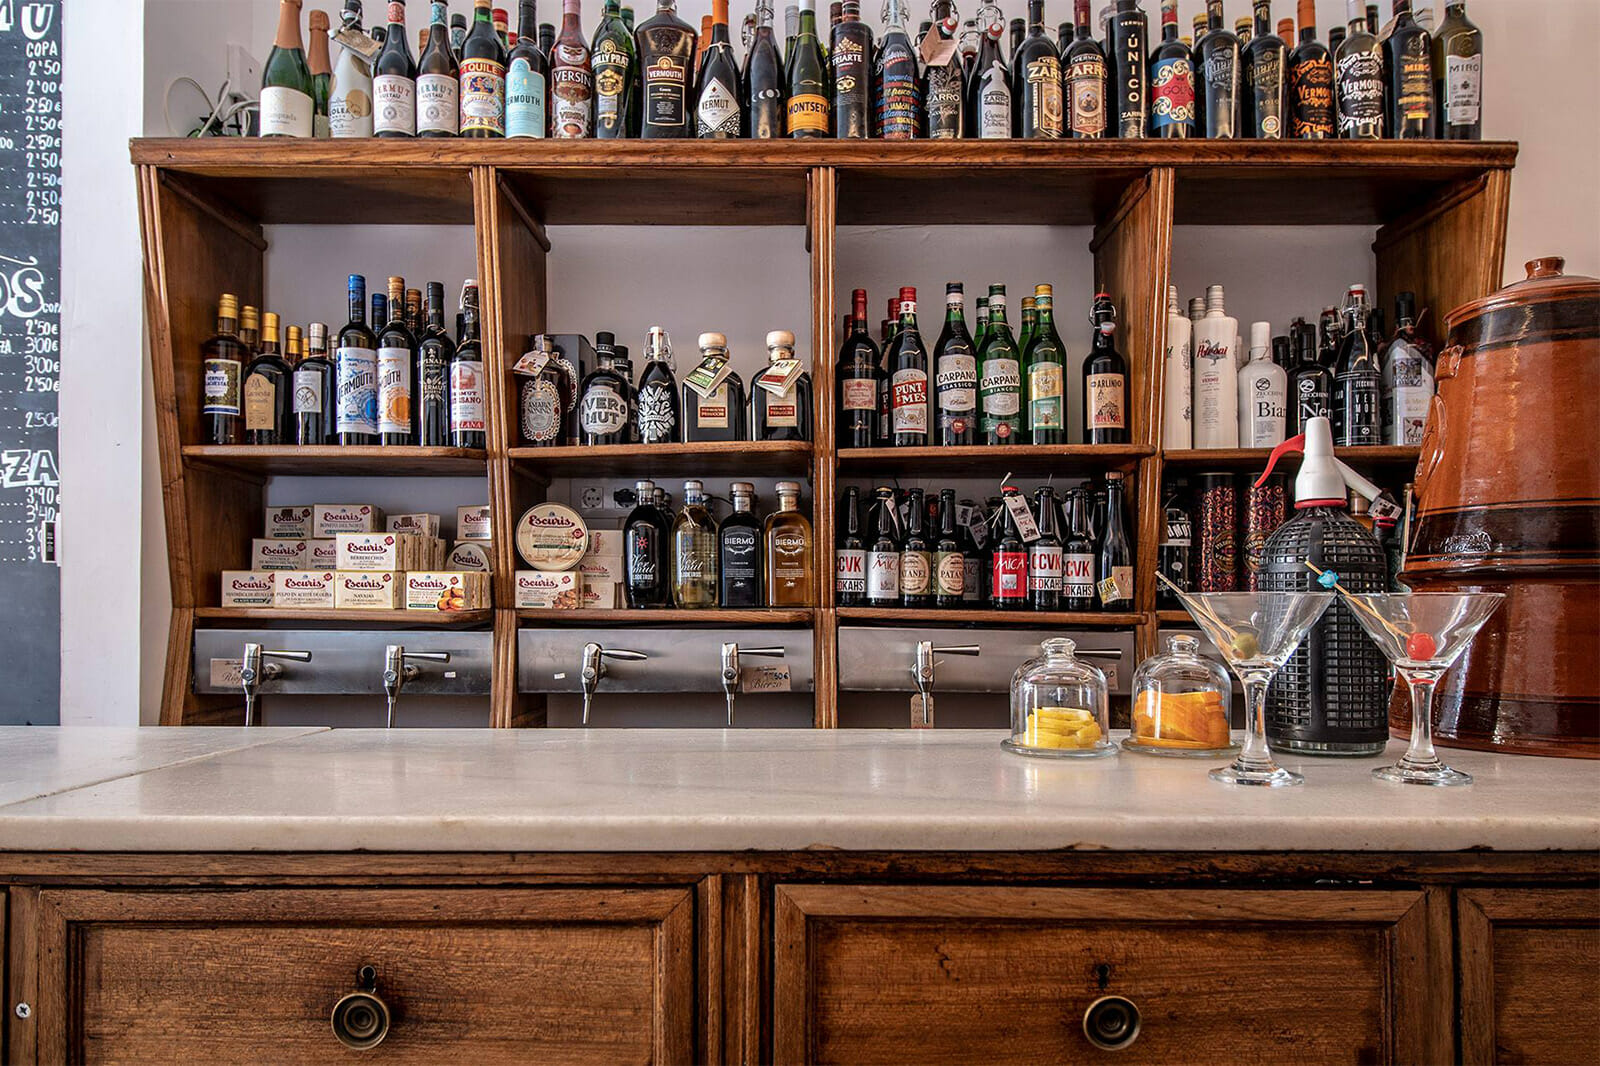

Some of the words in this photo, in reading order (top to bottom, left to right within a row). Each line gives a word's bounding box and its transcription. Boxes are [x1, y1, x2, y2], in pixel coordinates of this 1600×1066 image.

[26, 41, 58, 58] COPA
[1064, 63, 1108, 81] ZARRO
[1127, 33, 1139, 102] ÚNICO
[649, 69, 682, 79] VERMOUTH
[506, 94, 541, 107] ERMOUTH
[702, 99, 729, 111] VERMUT
[25, 319, 59, 335] 2'50€
[938, 370, 976, 383] CARPANO
[982, 375, 1019, 388] CARPANO
[895, 382, 923, 396] PUNT
[989, 386, 1014, 394] BIANCO
[902, 393, 927, 404] MES
[0, 449, 60, 488] ZA
[323, 511, 363, 523] Escuris
[529, 515, 575, 528] Escuris
[261, 546, 299, 557] Escuris
[314, 547, 336, 557] Escur
[347, 542, 388, 554] Escuris
[453, 552, 483, 567] Escuris
[837, 556, 862, 573] CVK
[994, 557, 1025, 571] MICA
[232, 580, 271, 591] Escuris
[285, 578, 326, 589] Escuris
[345, 579, 385, 590] Escuris
[409, 579, 447, 590] Escuris
[519, 577, 559, 589] Escuris
